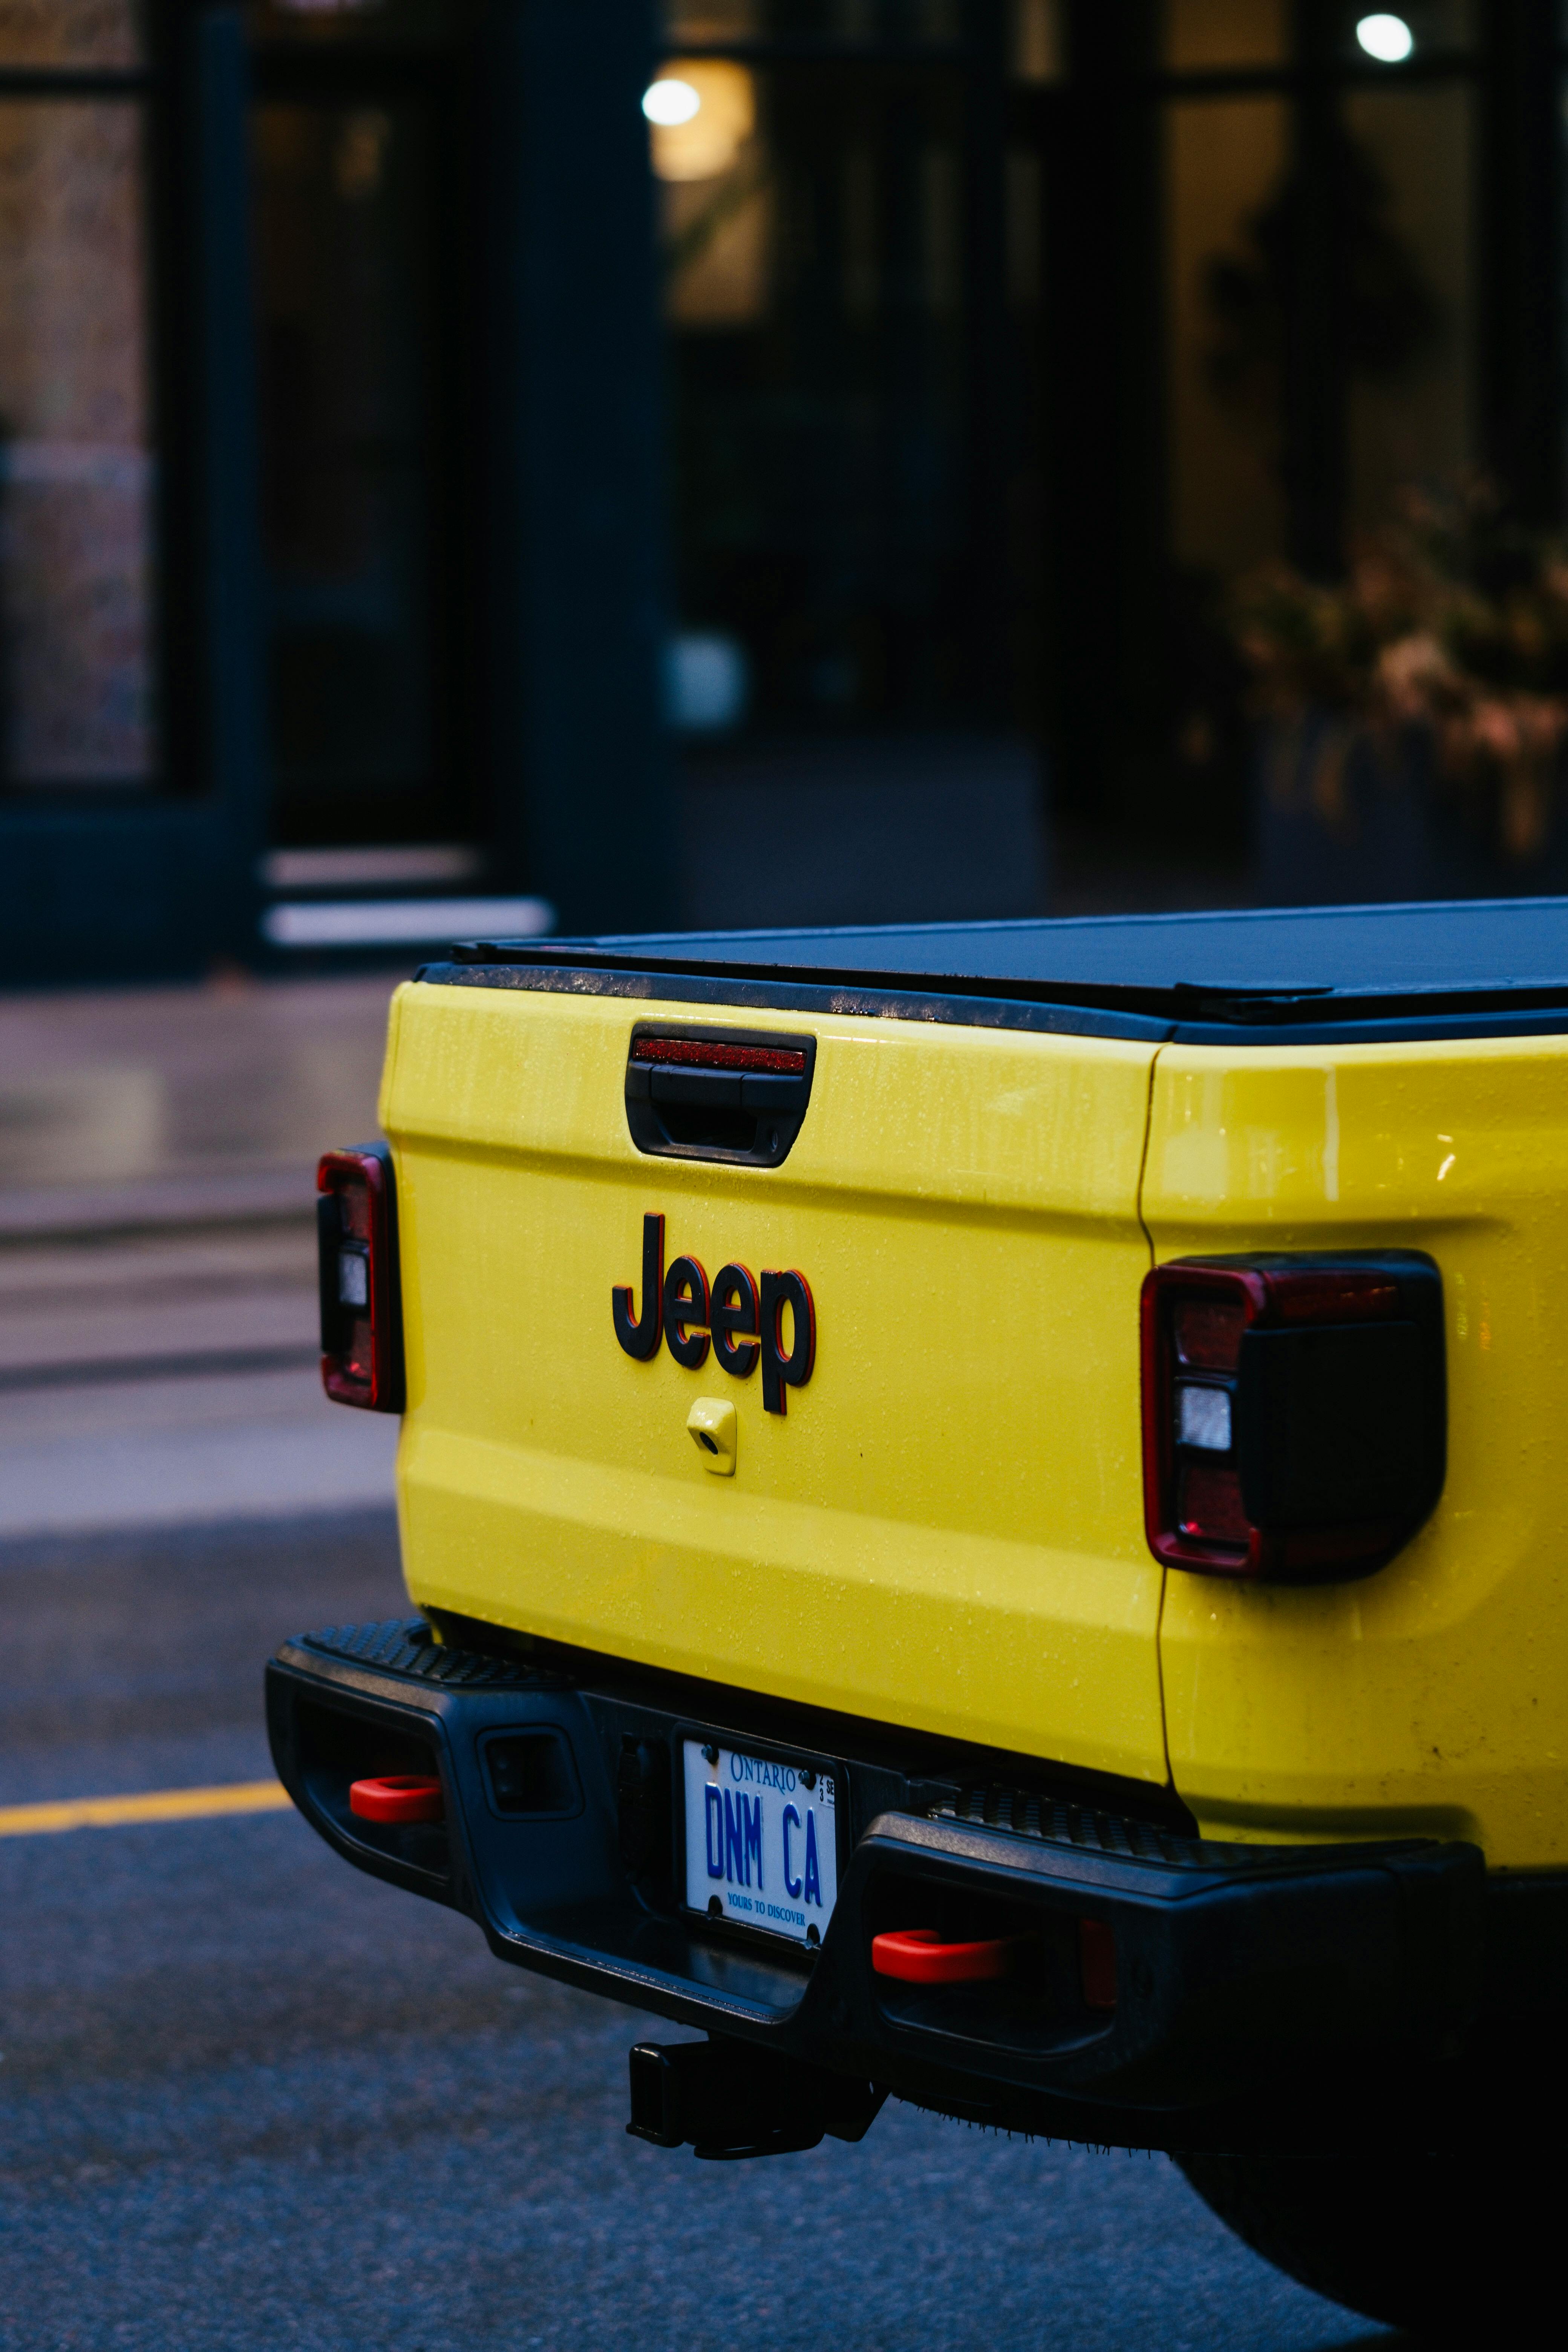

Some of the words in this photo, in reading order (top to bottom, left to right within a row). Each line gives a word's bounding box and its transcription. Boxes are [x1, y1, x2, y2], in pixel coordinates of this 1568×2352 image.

[612, 1212, 816, 1415] Jeep
[730, 1753, 796, 1795] ONTARIO
[705, 1782, 763, 1890] DNM
[782, 1802, 822, 1907] CA
[727, 1892, 752, 1911] YOURS
[755, 1900, 765, 1914] TO
[768, 1904, 805, 1926] DISCOVER
